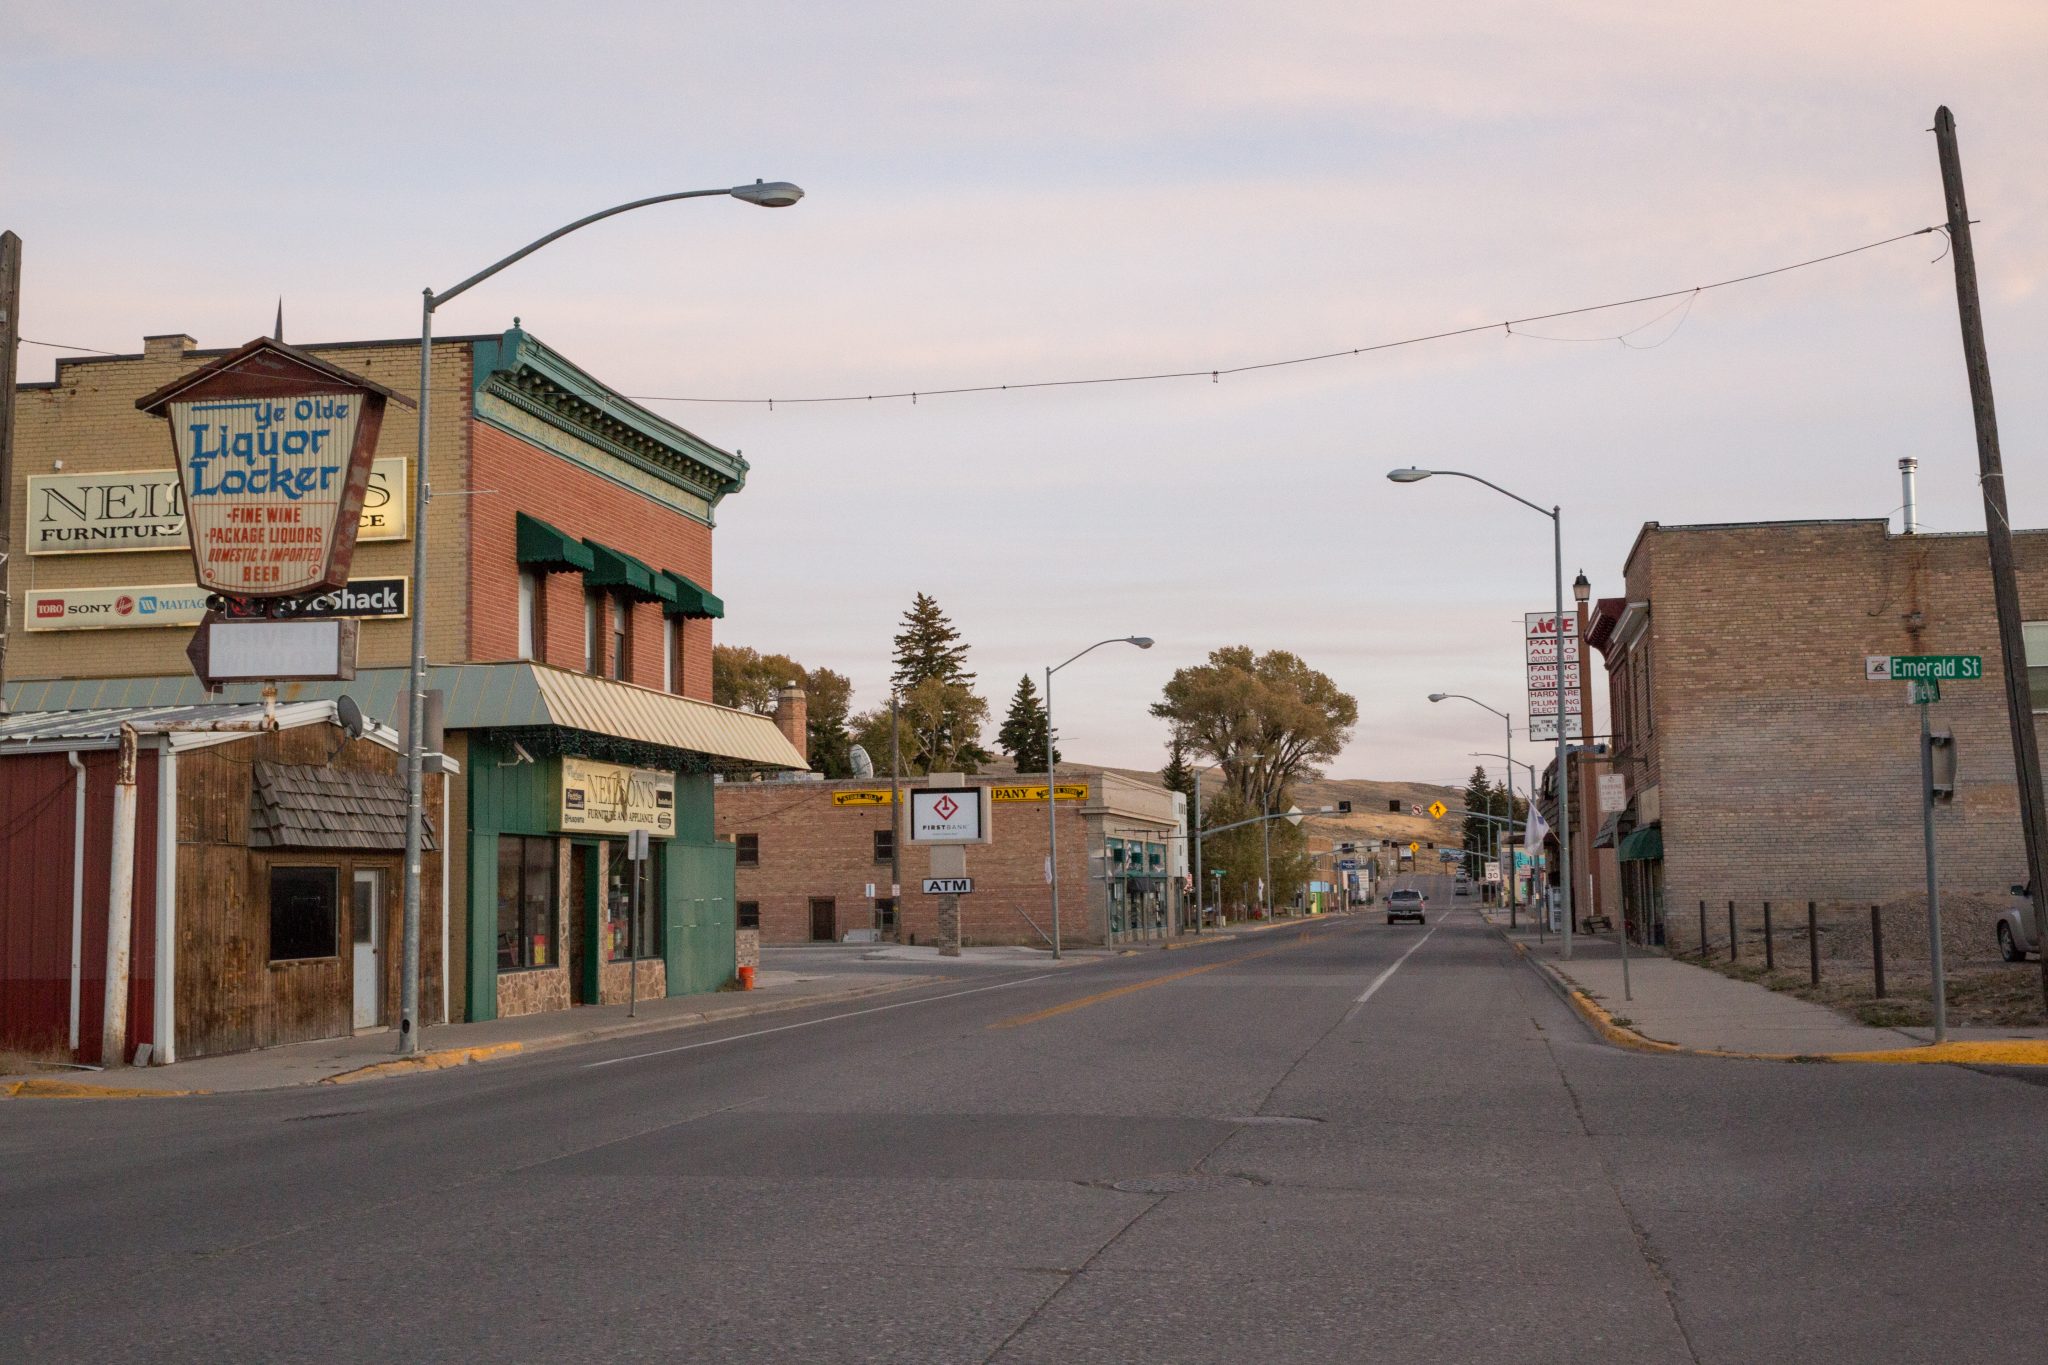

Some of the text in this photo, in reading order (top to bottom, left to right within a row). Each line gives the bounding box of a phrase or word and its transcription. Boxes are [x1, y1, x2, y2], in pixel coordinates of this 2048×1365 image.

[254, 400, 349, 429] Ye Olde
[189, 424, 331, 466] Liquor
[189, 457, 340, 500] Locker
[232, 507, 302, 523] FINE WINE
[209, 527, 322, 544] PACKAGE LIQUORS
[208, 548, 259, 562] DOMESTIC
[269, 548, 322, 562] IMPORTED
[242, 566, 280, 582] BEER
[38, 604, 63, 614] TORO
[67, 604, 112, 614] SONY
[159, 599, 205, 611] MAYTAG
[1531, 617, 1575, 633] ACE
[1892, 658, 1979, 677] Emerald St
[929, 880, 967, 891] ATM
